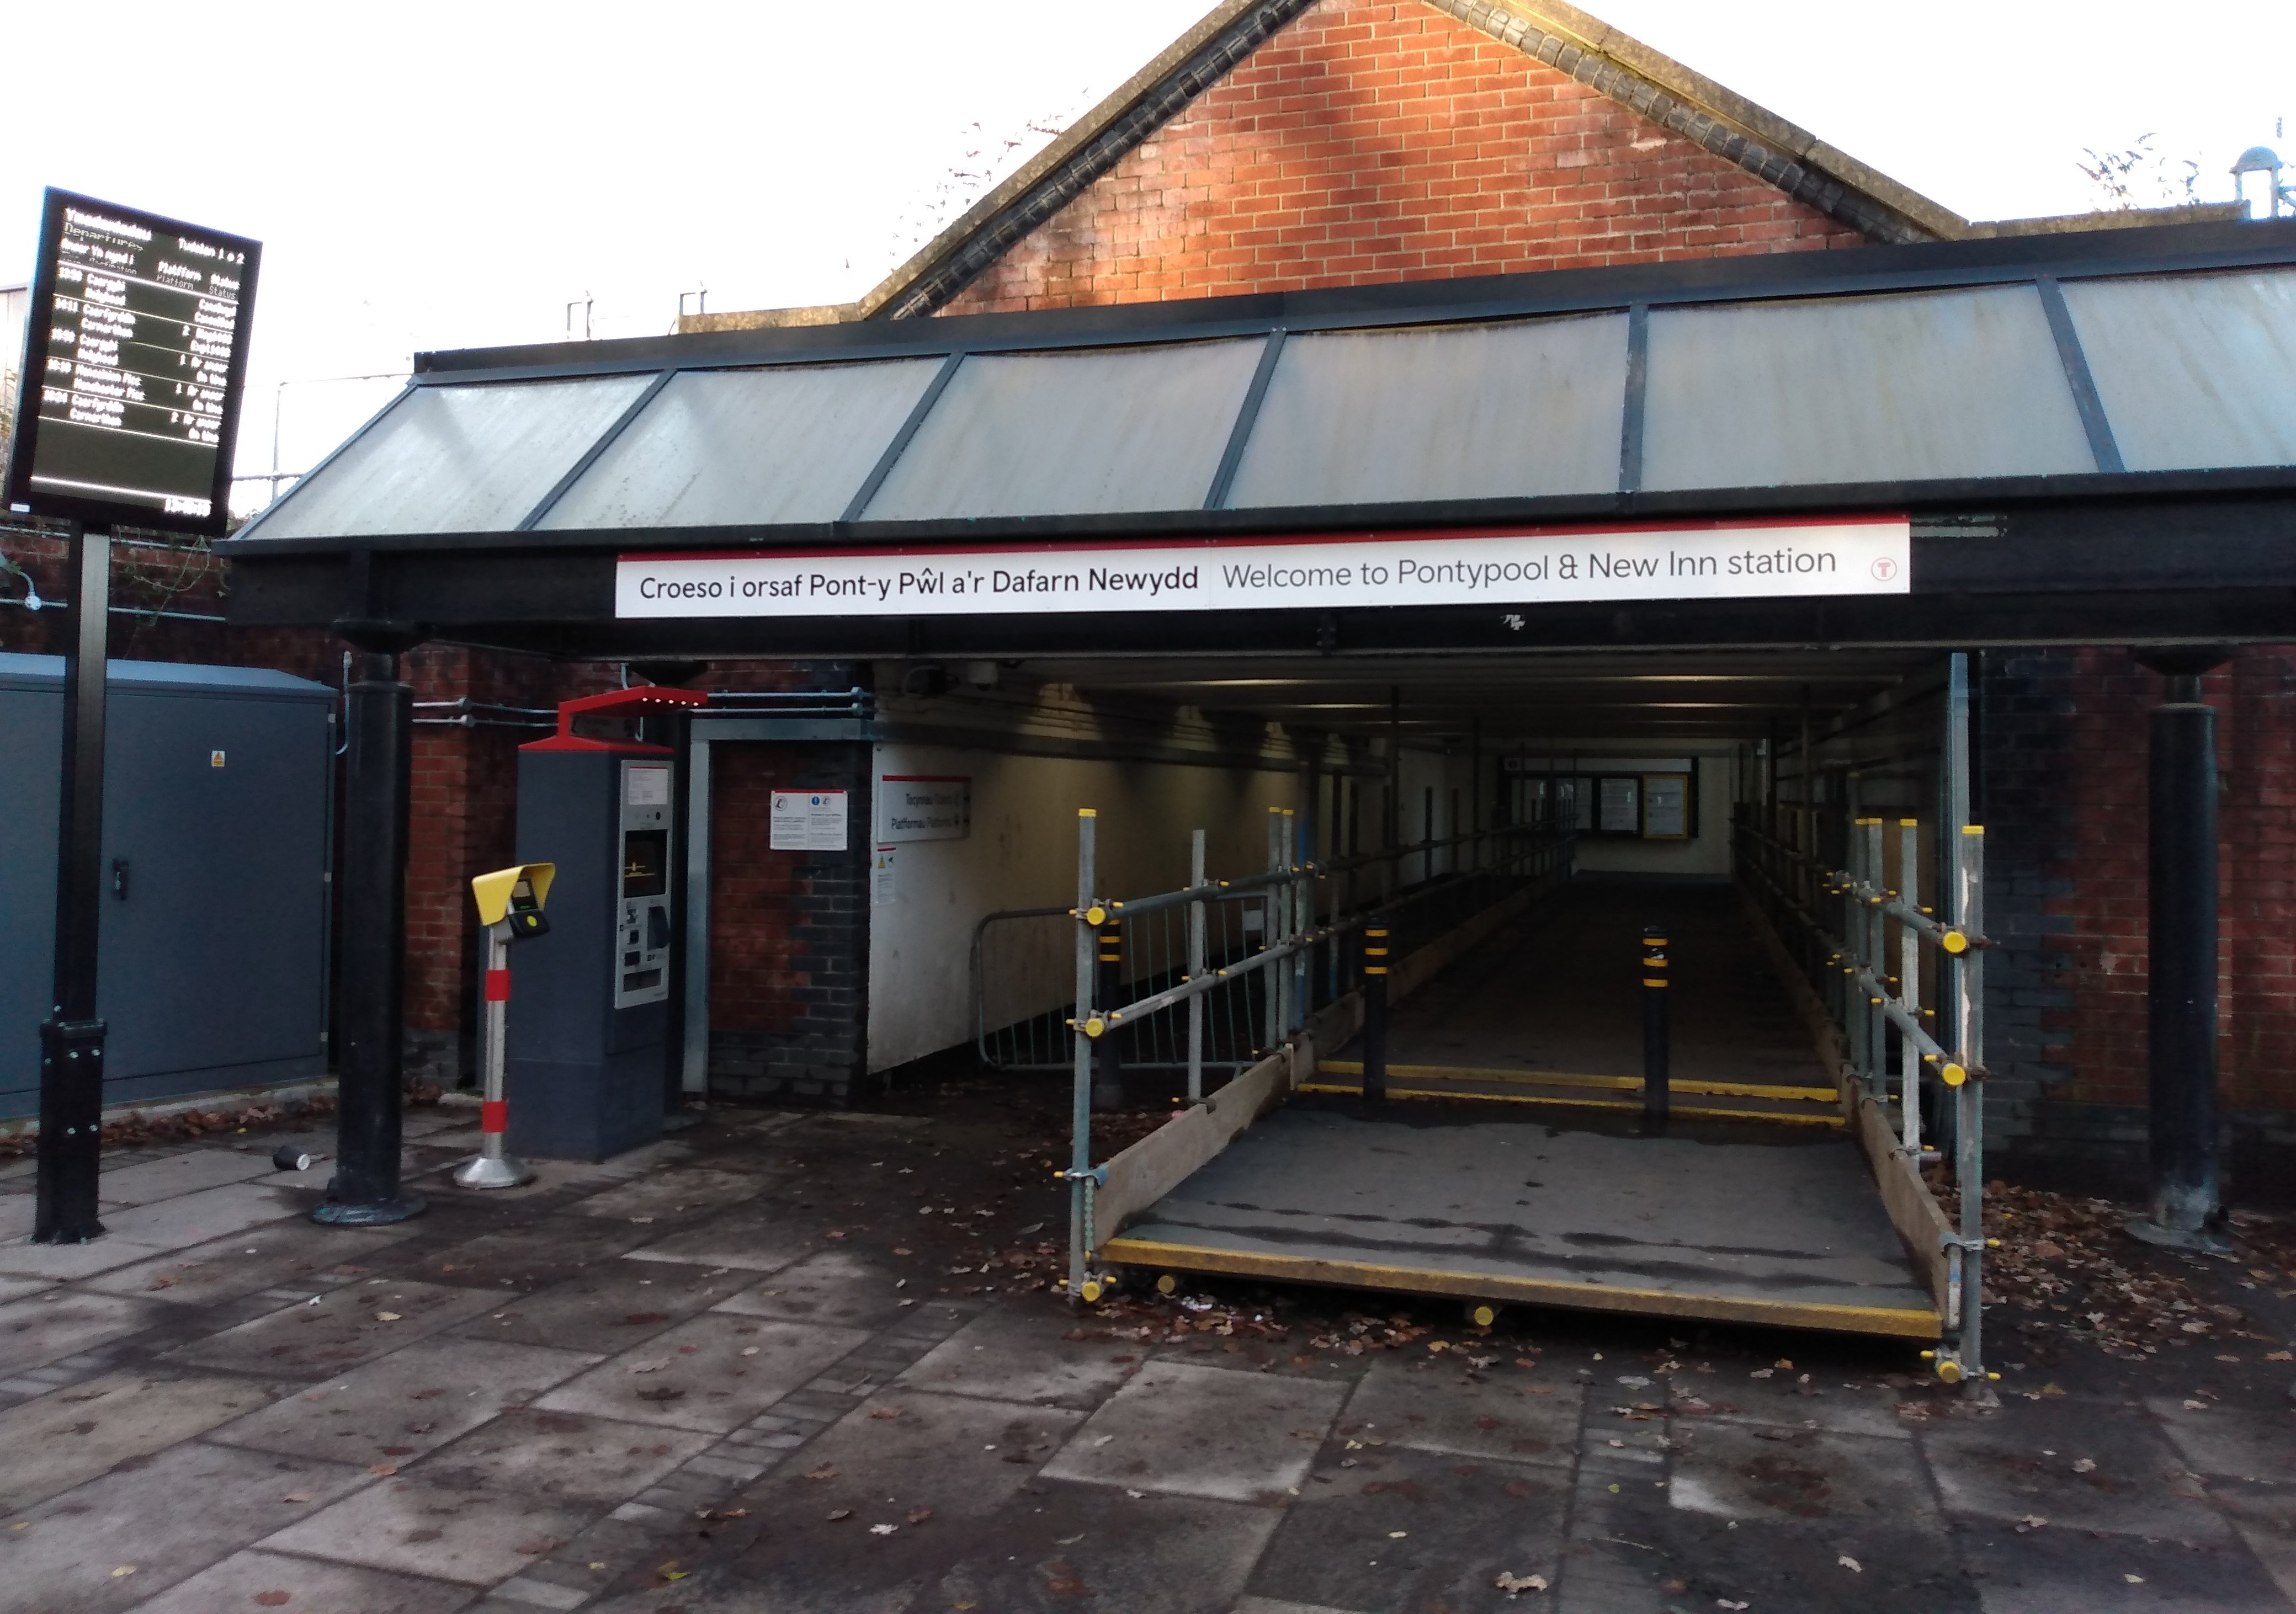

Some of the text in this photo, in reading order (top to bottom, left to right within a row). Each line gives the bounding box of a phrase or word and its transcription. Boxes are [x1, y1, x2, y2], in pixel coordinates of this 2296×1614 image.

[219, 247, 224, 260] 1
[237, 252, 245, 264] 2
[156, 273, 237, 300] Platform Status
[182, 324, 190, 337] 2
[1223, 547, 1835, 589] Welcome to Pontypool & New Inn station
[640, 566, 1198, 601] Croeso i orsaf Pont-y Pŵl a'r Dafarn Newydd
